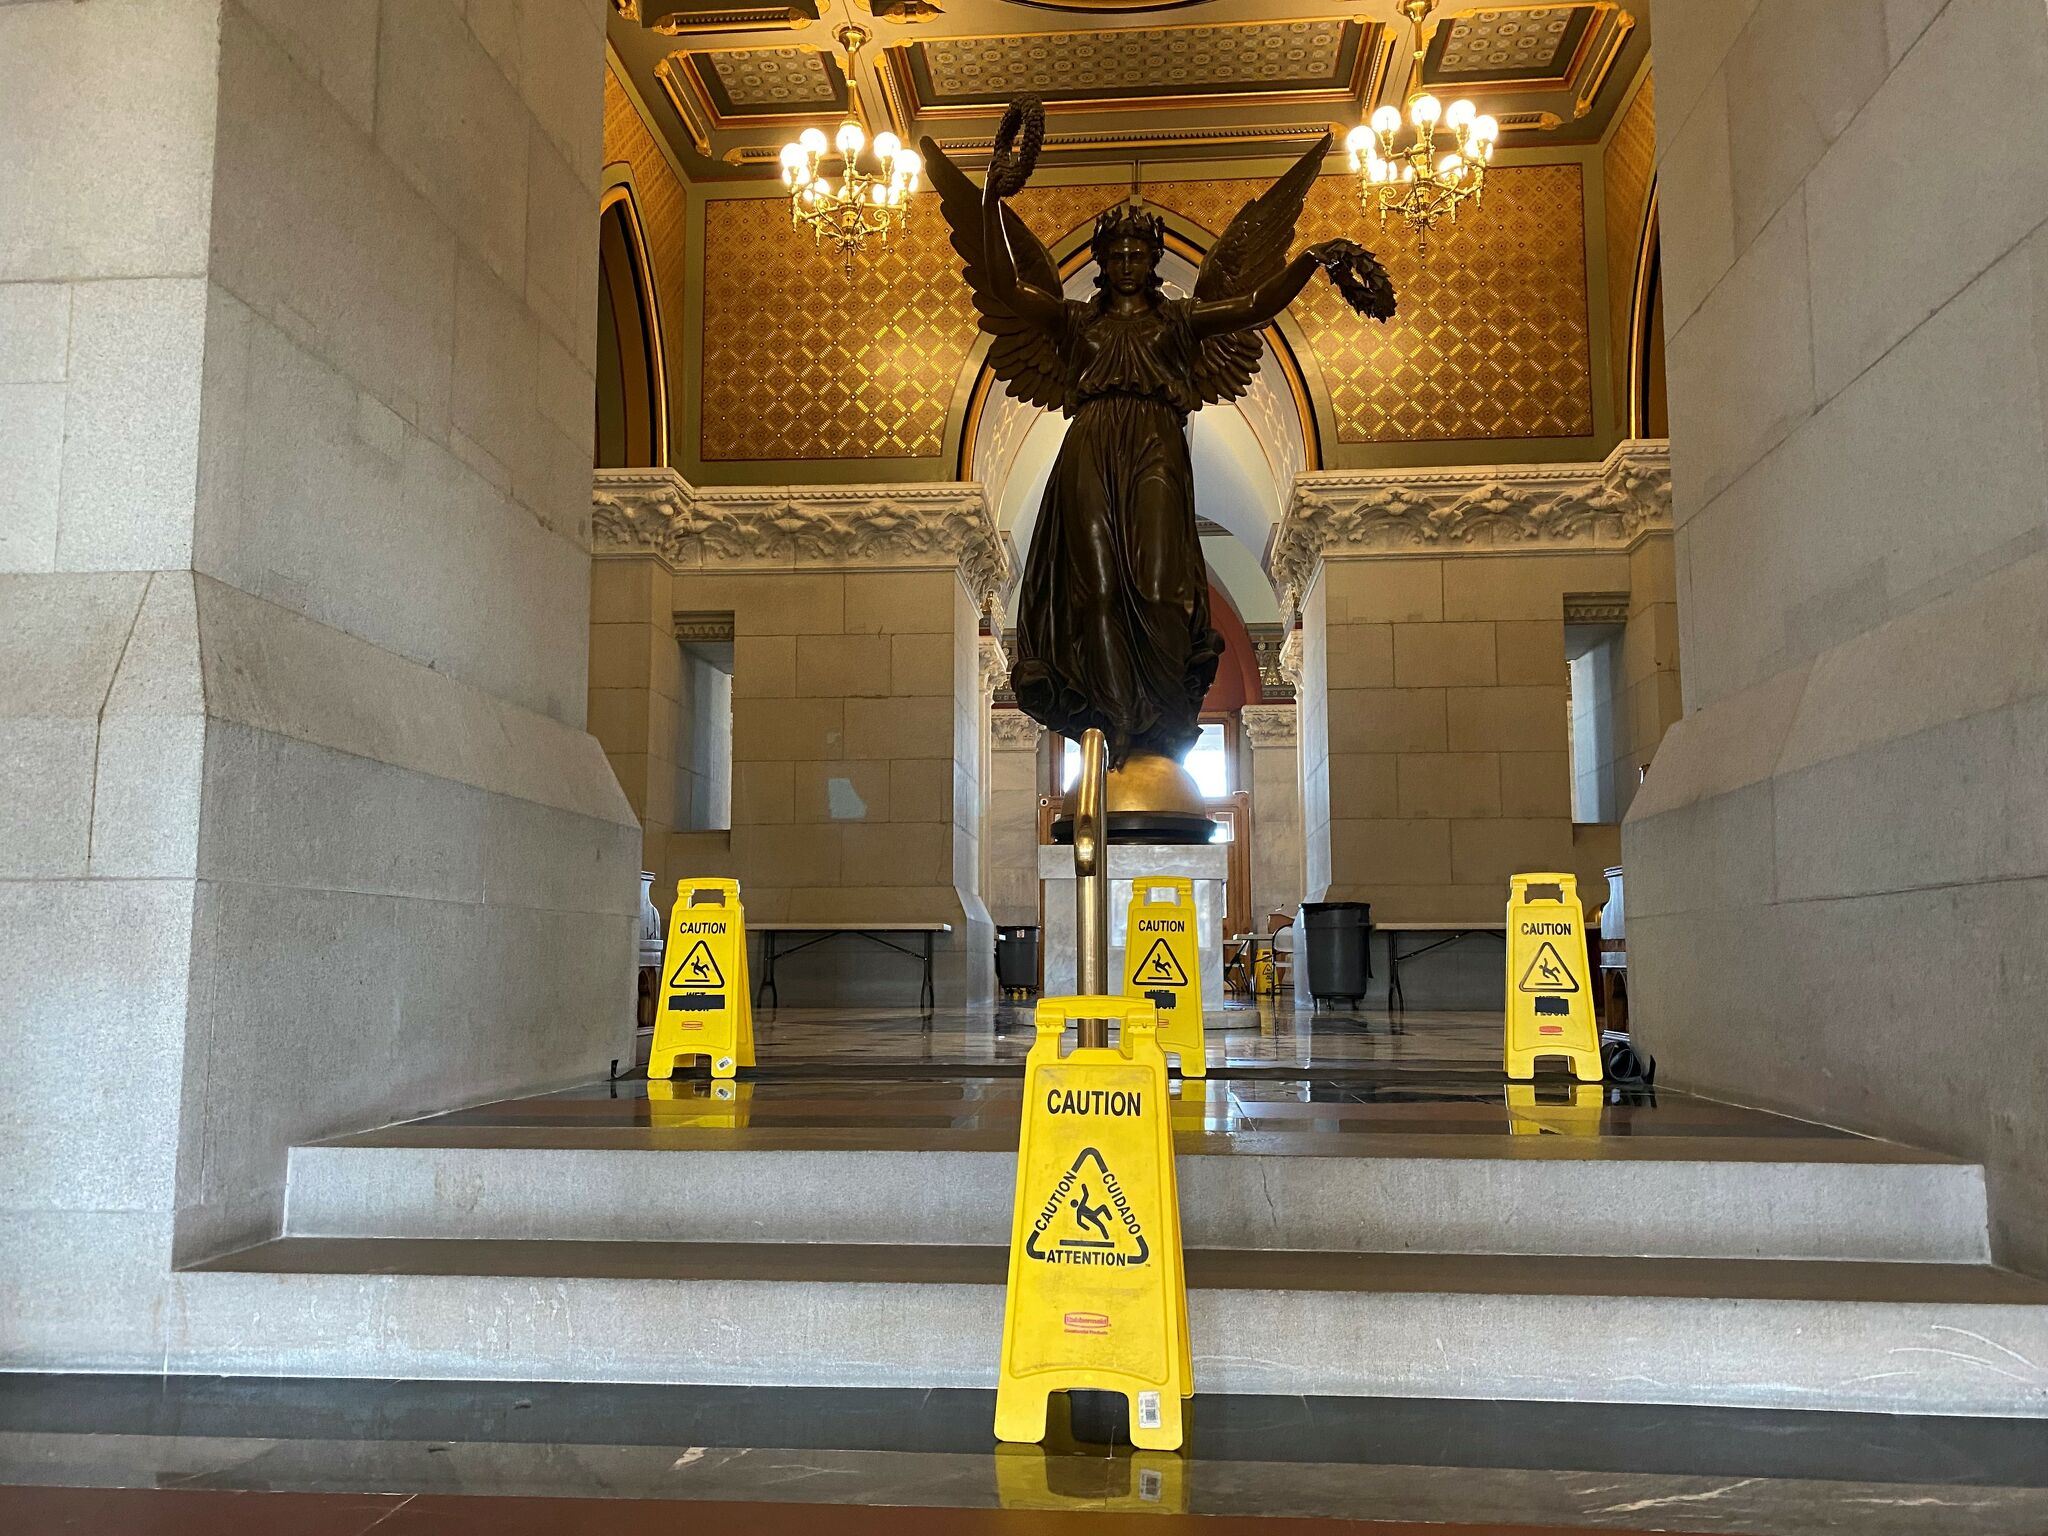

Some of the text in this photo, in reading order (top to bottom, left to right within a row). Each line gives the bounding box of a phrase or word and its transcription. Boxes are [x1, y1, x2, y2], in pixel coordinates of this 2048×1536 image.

[680, 922, 726, 934] CAUTION
[1138, 919, 1185, 932] CAUTION
[1521, 922, 1572, 935] CAUTION
[1047, 1089, 1141, 1116] CAUTION
[1034, 1171, 1077, 1231] CAUTION
[1102, 1173, 1141, 1235] CUIDADO
[1046, 1249, 1126, 1266] ATTENTION
